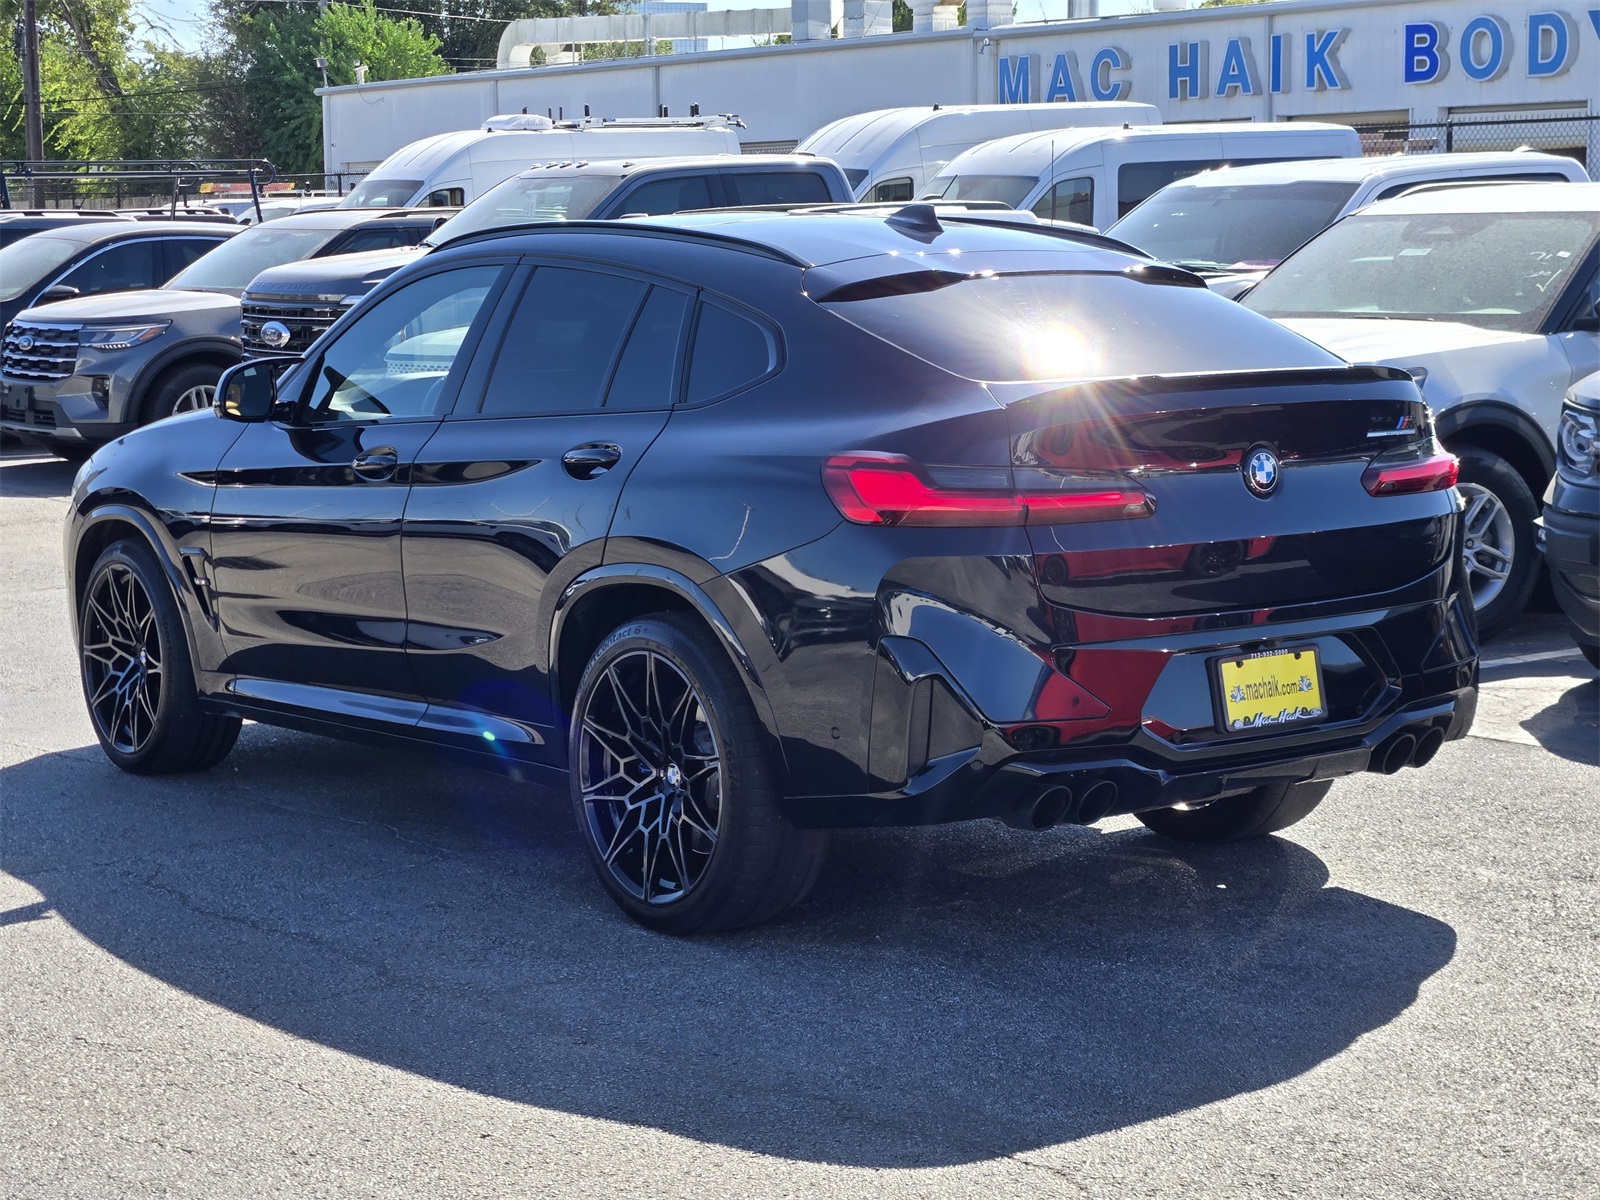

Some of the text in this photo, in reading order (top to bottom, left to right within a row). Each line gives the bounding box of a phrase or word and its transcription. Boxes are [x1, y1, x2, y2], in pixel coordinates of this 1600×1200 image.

[998, 10, 1600, 103] MAC HAIK BOD
[1252, 454, 1276, 467] BMW
[634, 625, 642, 635] 6
[1245, 675, 1299, 701] machaik.com
[1254, 712, 1276, 728] Mac
[1278, 707, 1302, 723] Haik
